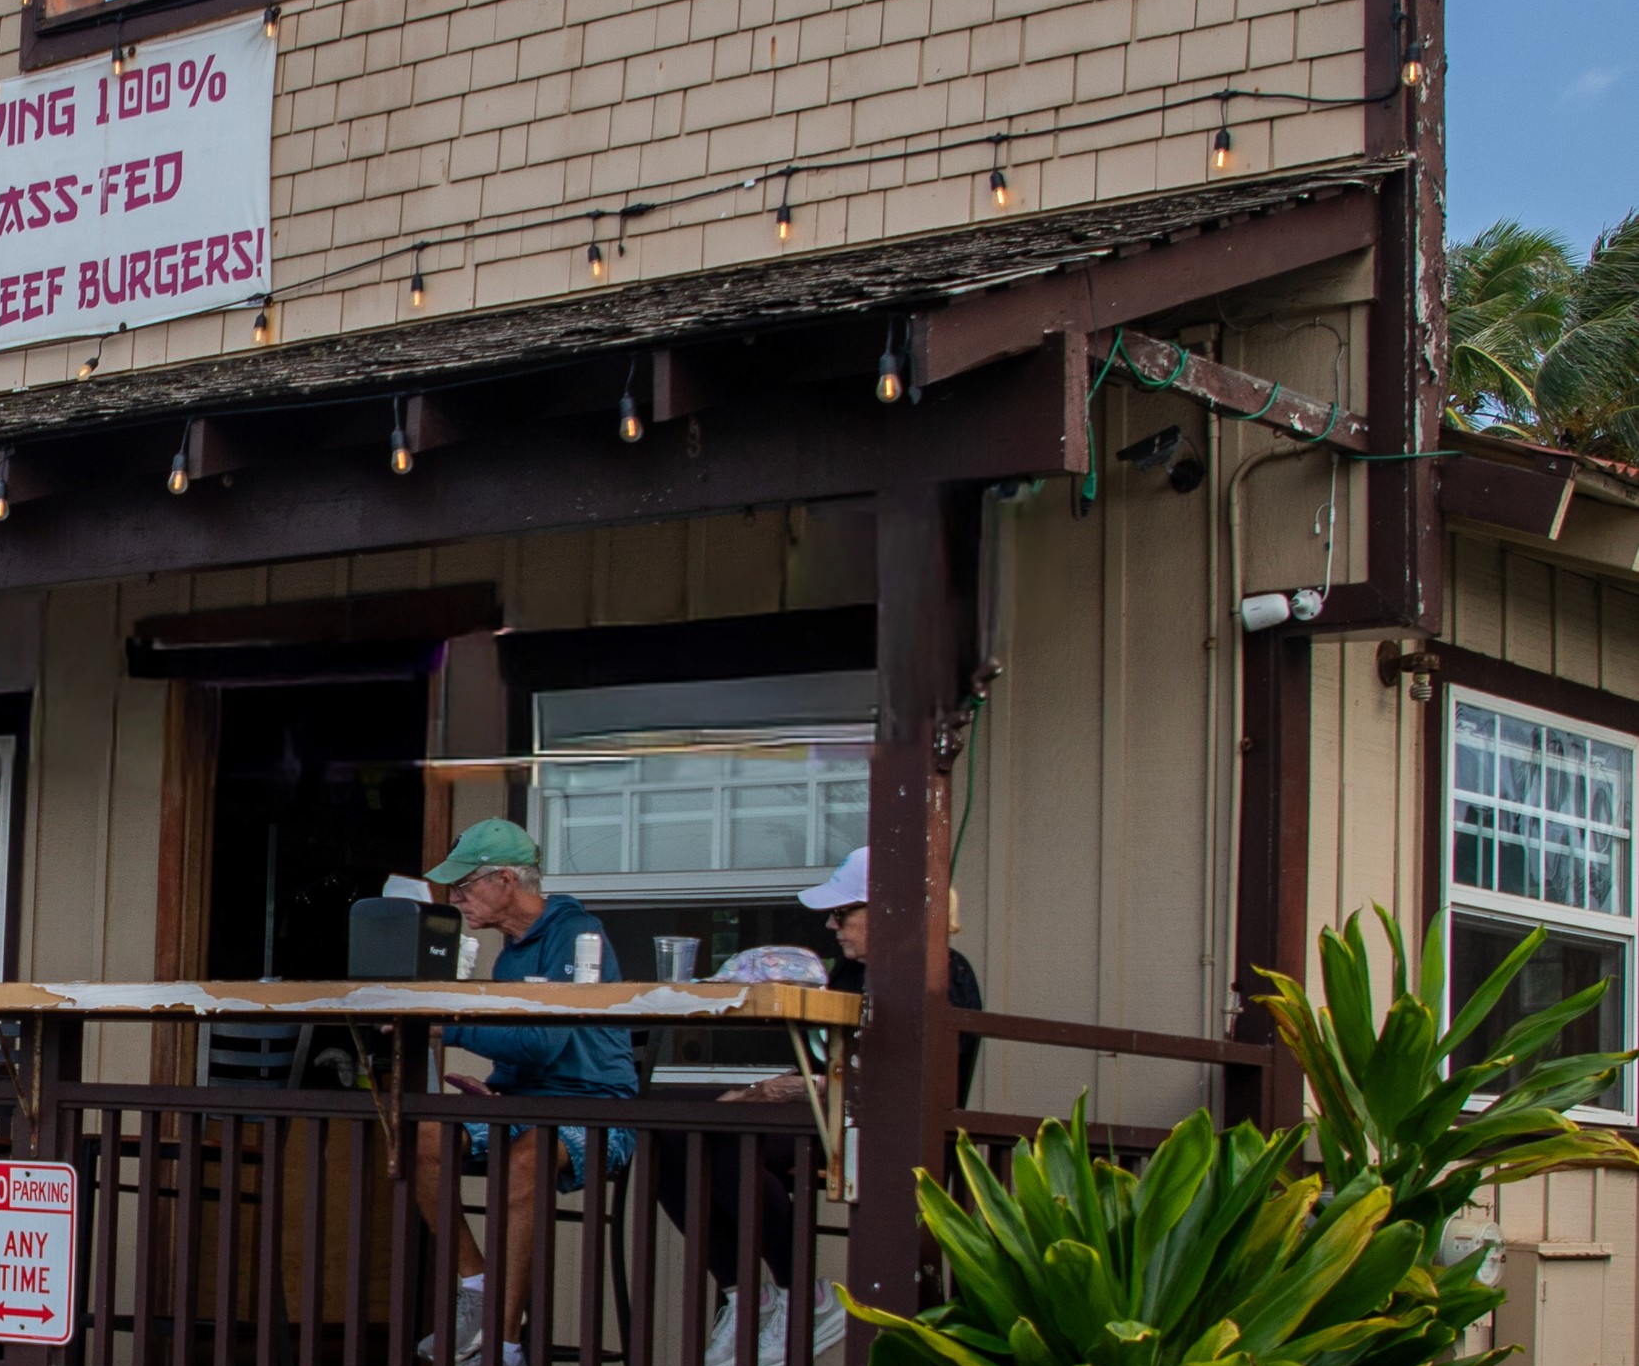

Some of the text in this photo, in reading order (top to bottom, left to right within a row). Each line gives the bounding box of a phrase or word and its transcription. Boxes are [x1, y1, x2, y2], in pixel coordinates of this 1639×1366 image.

[95, 53, 228, 126] 100%
[78, 227, 266, 311] BURGERS!
[12, 1180, 70, 1204] PARKING
[3, 1230, 49, 1259] ANY
[0, 1264, 51, 1294] TIME
